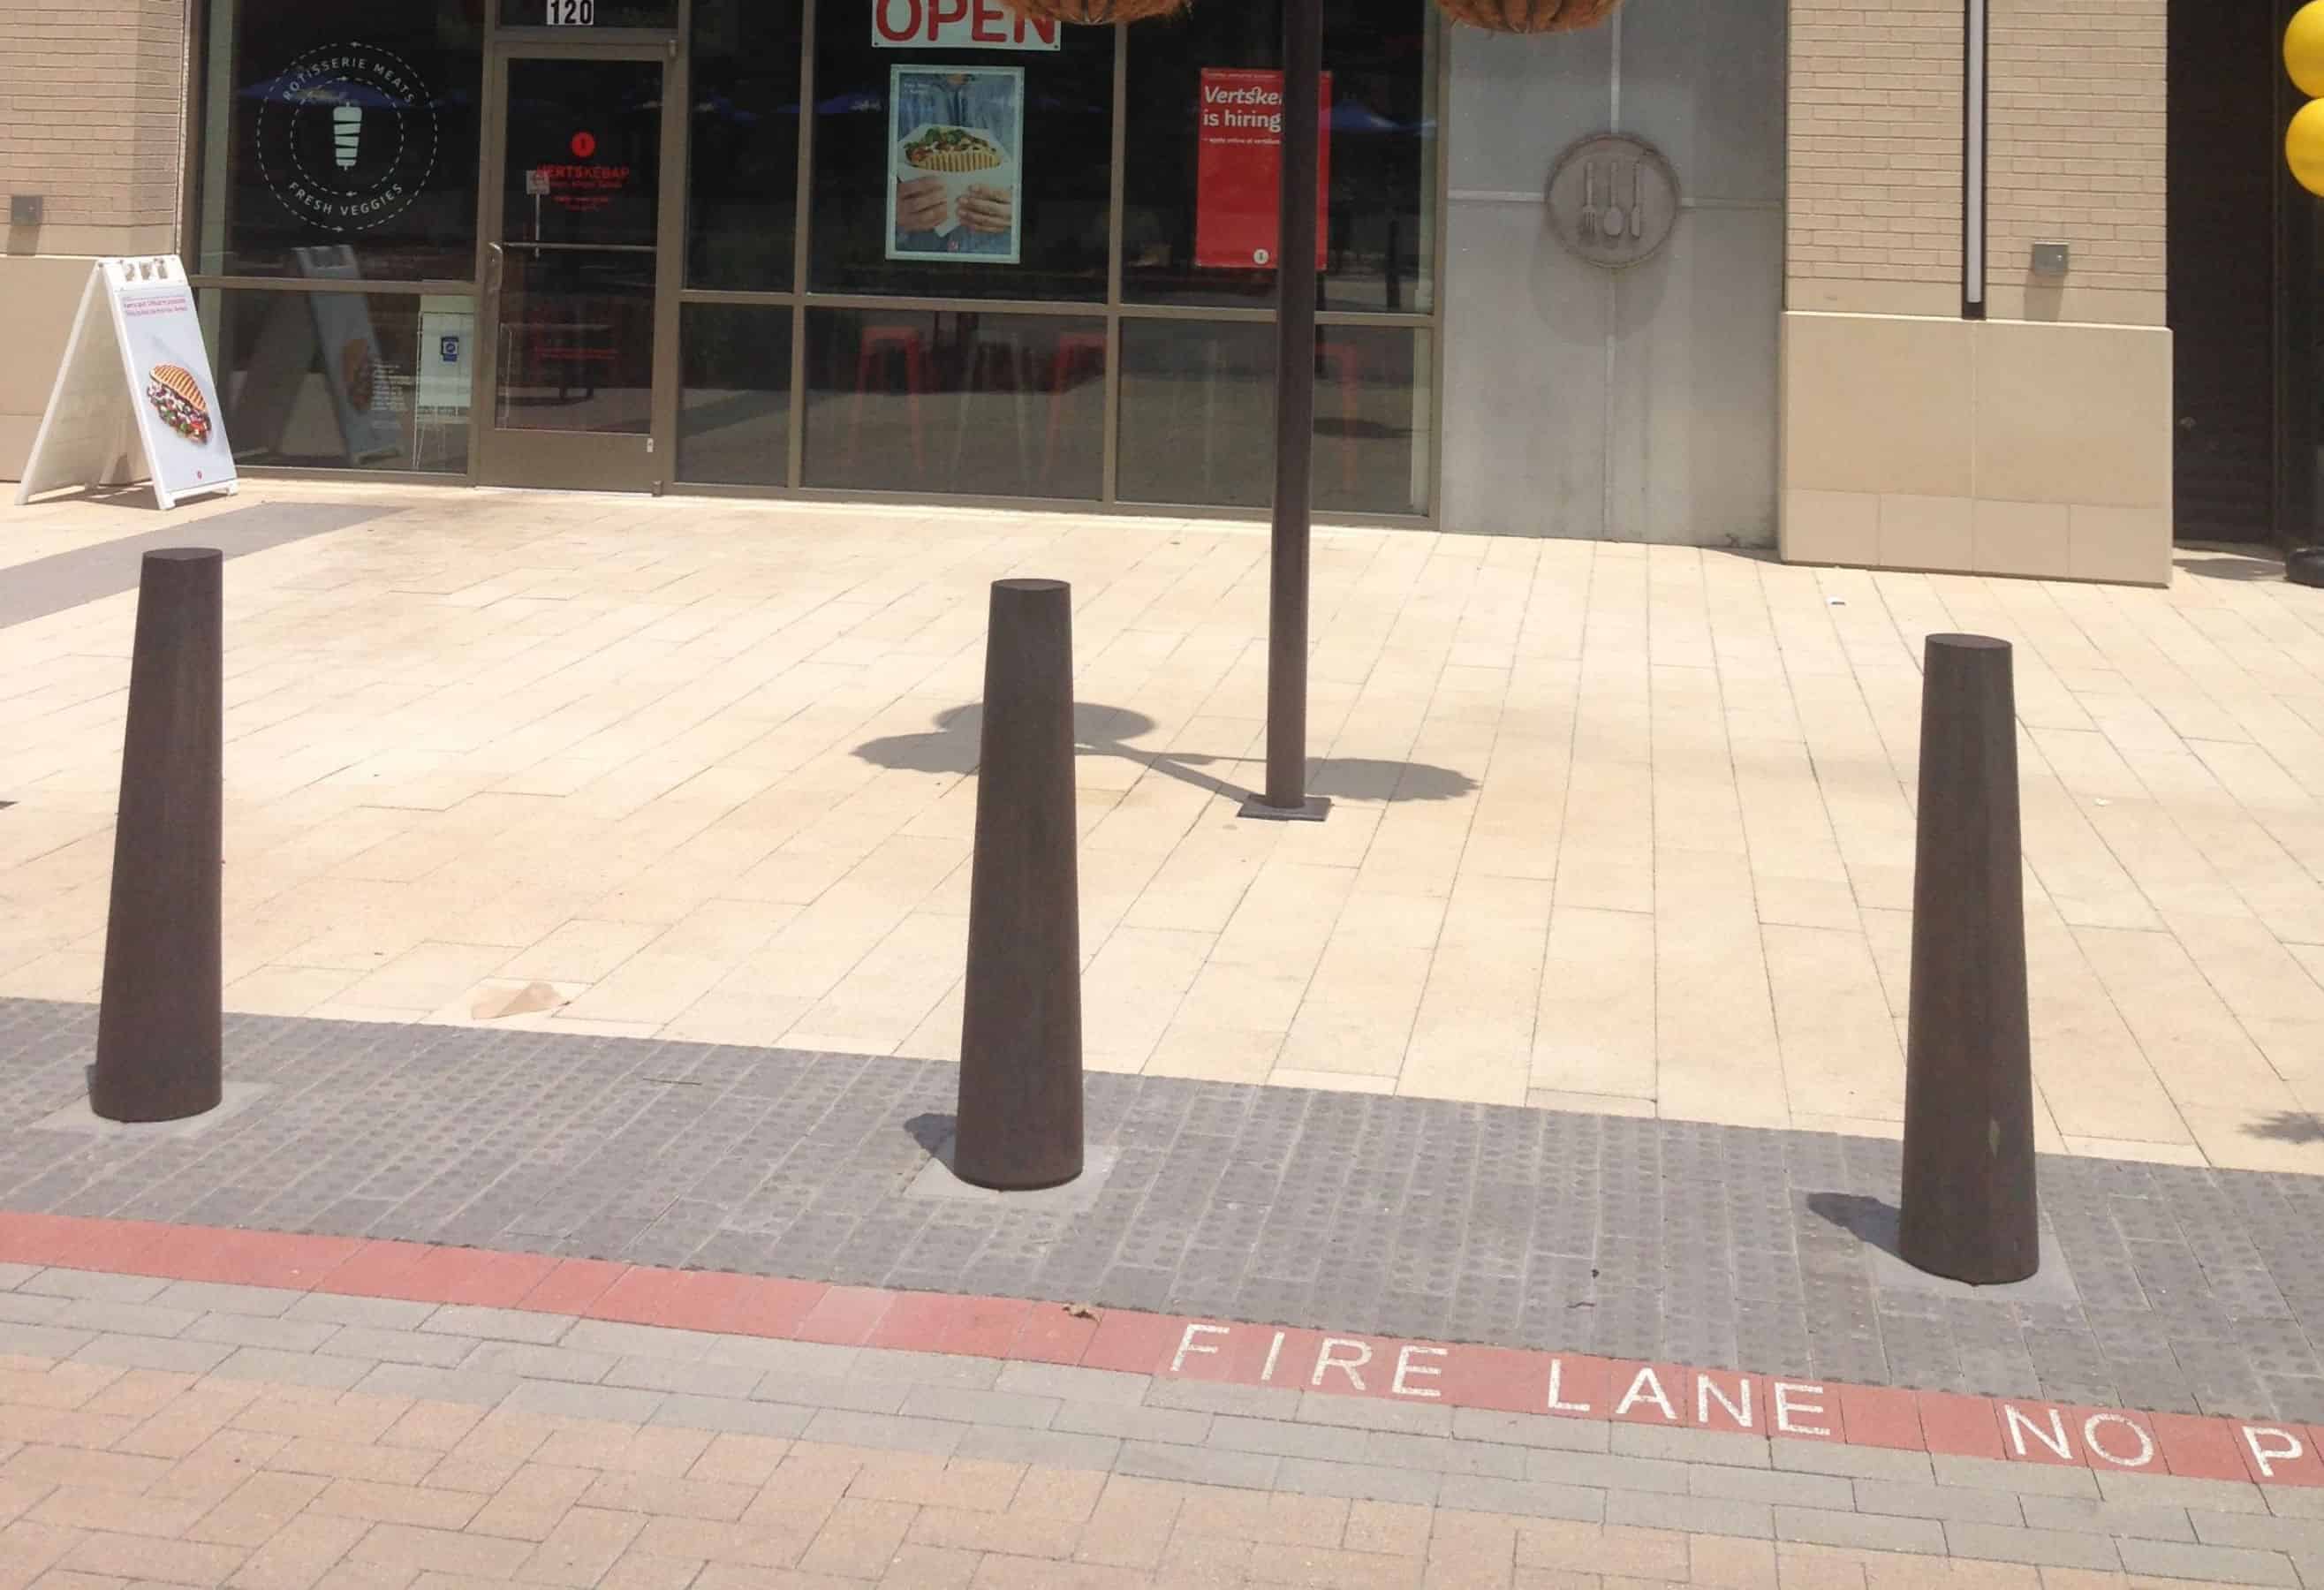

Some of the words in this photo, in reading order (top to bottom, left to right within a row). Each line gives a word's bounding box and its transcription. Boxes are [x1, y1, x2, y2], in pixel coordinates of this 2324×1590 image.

[550, 0, 592, 25] 120
[875, 0, 1055, 43] OPEN
[283, 57, 367, 101] ROTISSERIE
[373, 63, 415, 103] MEATS
[1204, 86, 1283, 105] Vertske
[1203, 108, 1219, 126] is
[1224, 109, 1281, 132] hiring
[289, 181, 333, 215] FRESH
[340, 183, 403, 216] VEGGIES
[1170, 1323, 1449, 1397] FIRE
[1548, 1359, 1831, 1435] LANE
[2004, 1404, 2154, 1466] NO
[2241, 1425, 2304, 1477] P
